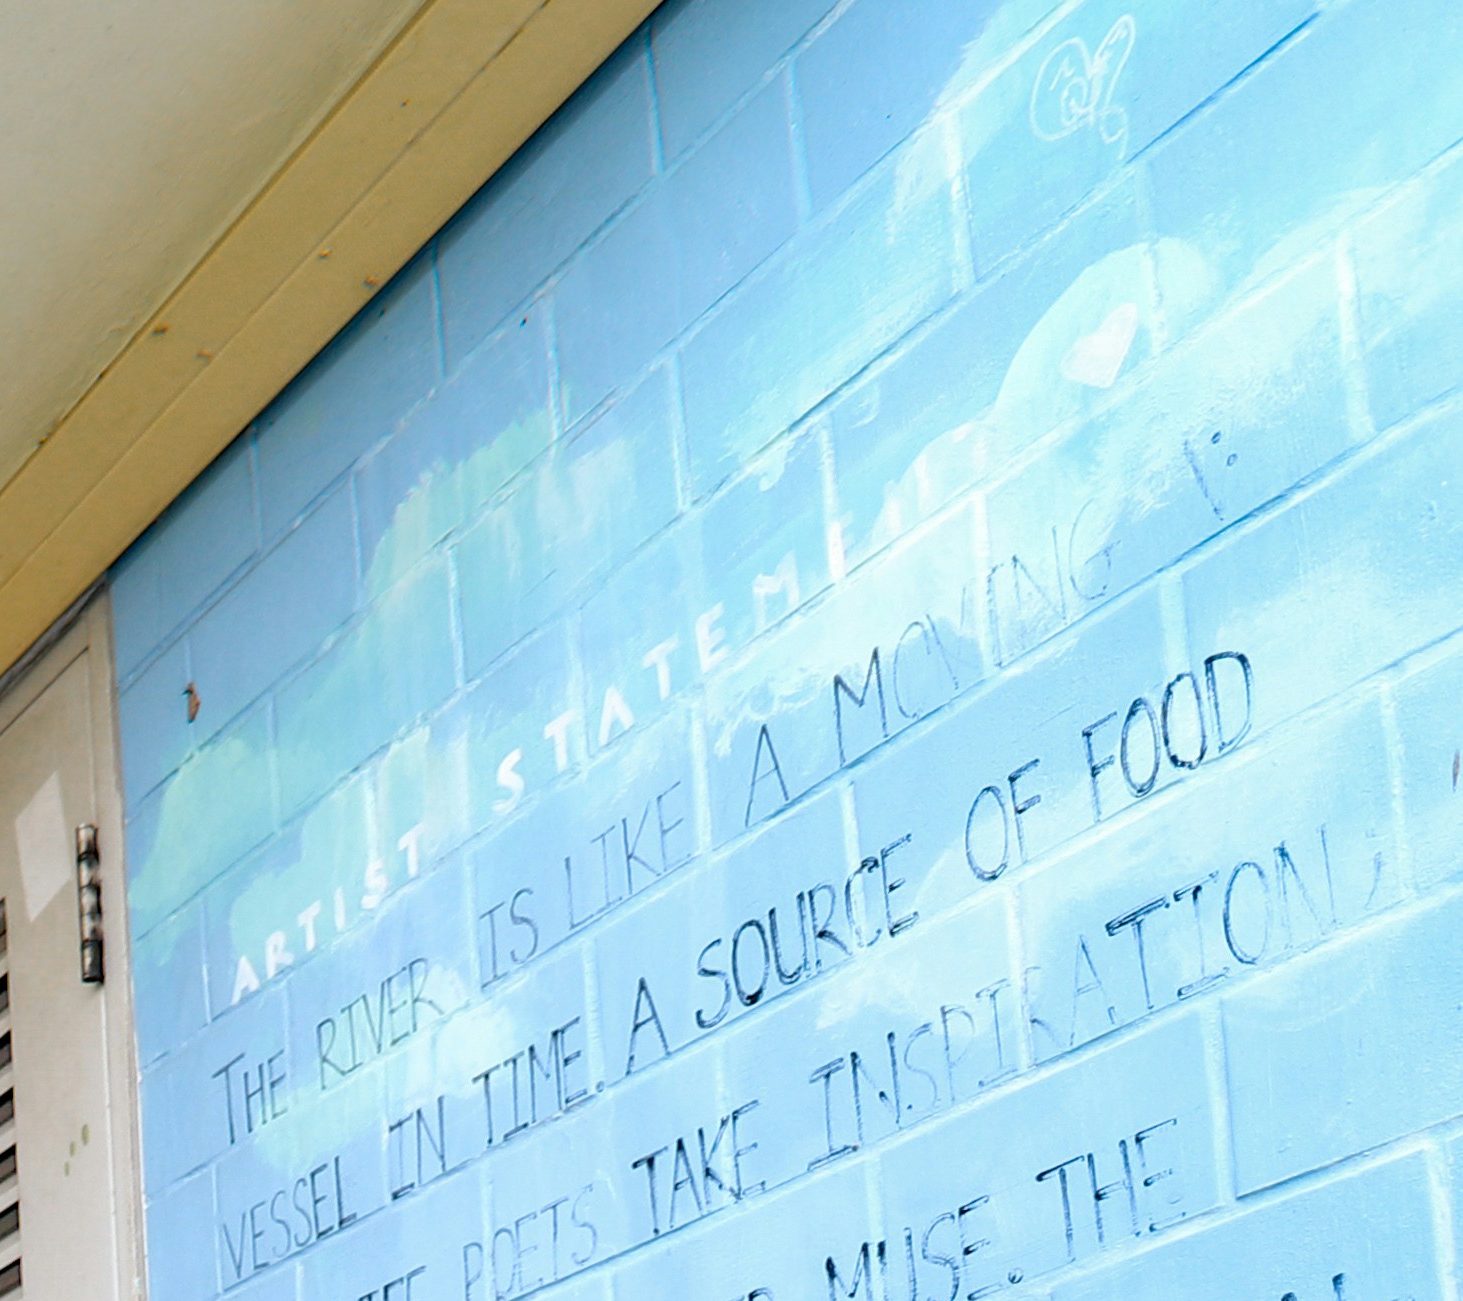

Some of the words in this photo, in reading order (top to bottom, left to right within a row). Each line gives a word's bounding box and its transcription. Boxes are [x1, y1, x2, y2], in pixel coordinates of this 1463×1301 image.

[212, 1052, 288, 1145] THE
[316, 958, 446, 1091] RIVER
[479, 888, 539, 992] IS
[564, 781, 683, 931] LIKE
[744, 724, 790, 828] A
[223, 1156, 357, 1280] VESSEL
[388, 1096, 447, 1200] IN
[473, 1017, 607, 1146] TIME.
[626, 977, 671, 1076] A
[696, 833, 919, 1030] SOURCE
[964, 757, 1042, 883] OF
[1081, 651, 1254, 824] FOOD
[231, 828, 423, 1005] ARTIST
[631, 1099, 768, 1236] TAKE
[1034, 1117, 1188, 1267] THE
